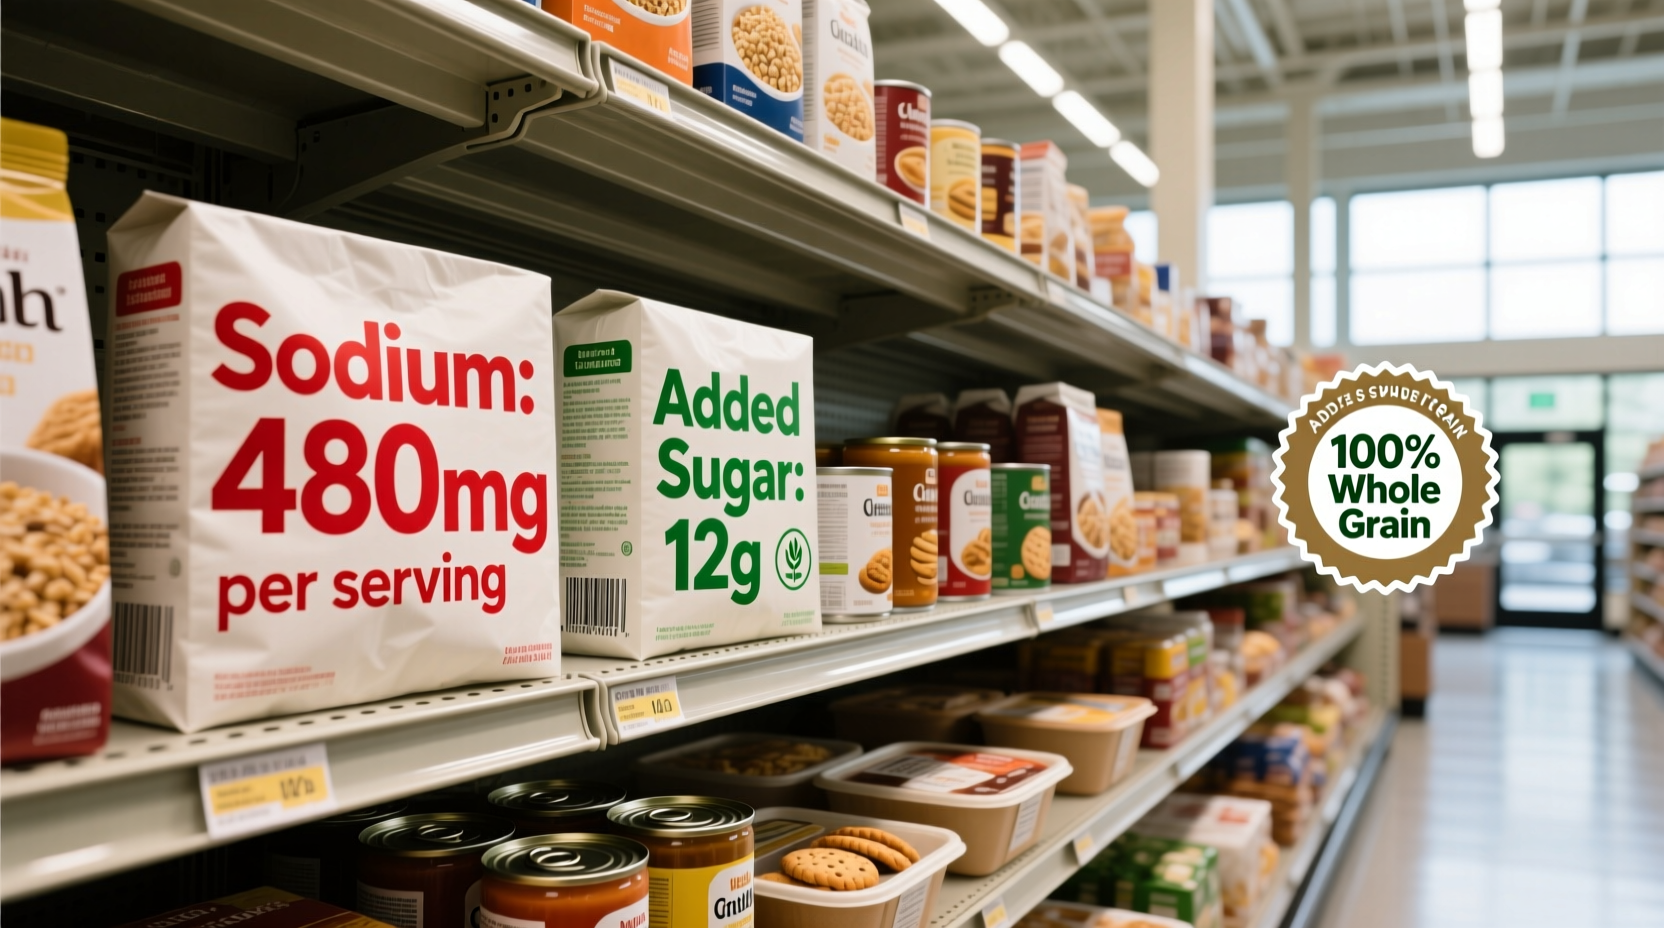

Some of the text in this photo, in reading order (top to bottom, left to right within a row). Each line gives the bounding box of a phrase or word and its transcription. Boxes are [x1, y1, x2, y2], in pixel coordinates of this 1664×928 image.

[211, 301, 534, 415] Sodium:
[653, 368, 800, 437] Added
[211, 417, 548, 555] 480mg
[656, 437, 805, 518] Sugar:
[218, 551, 507, 632] per serving
[664, 517, 761, 605] 12g
